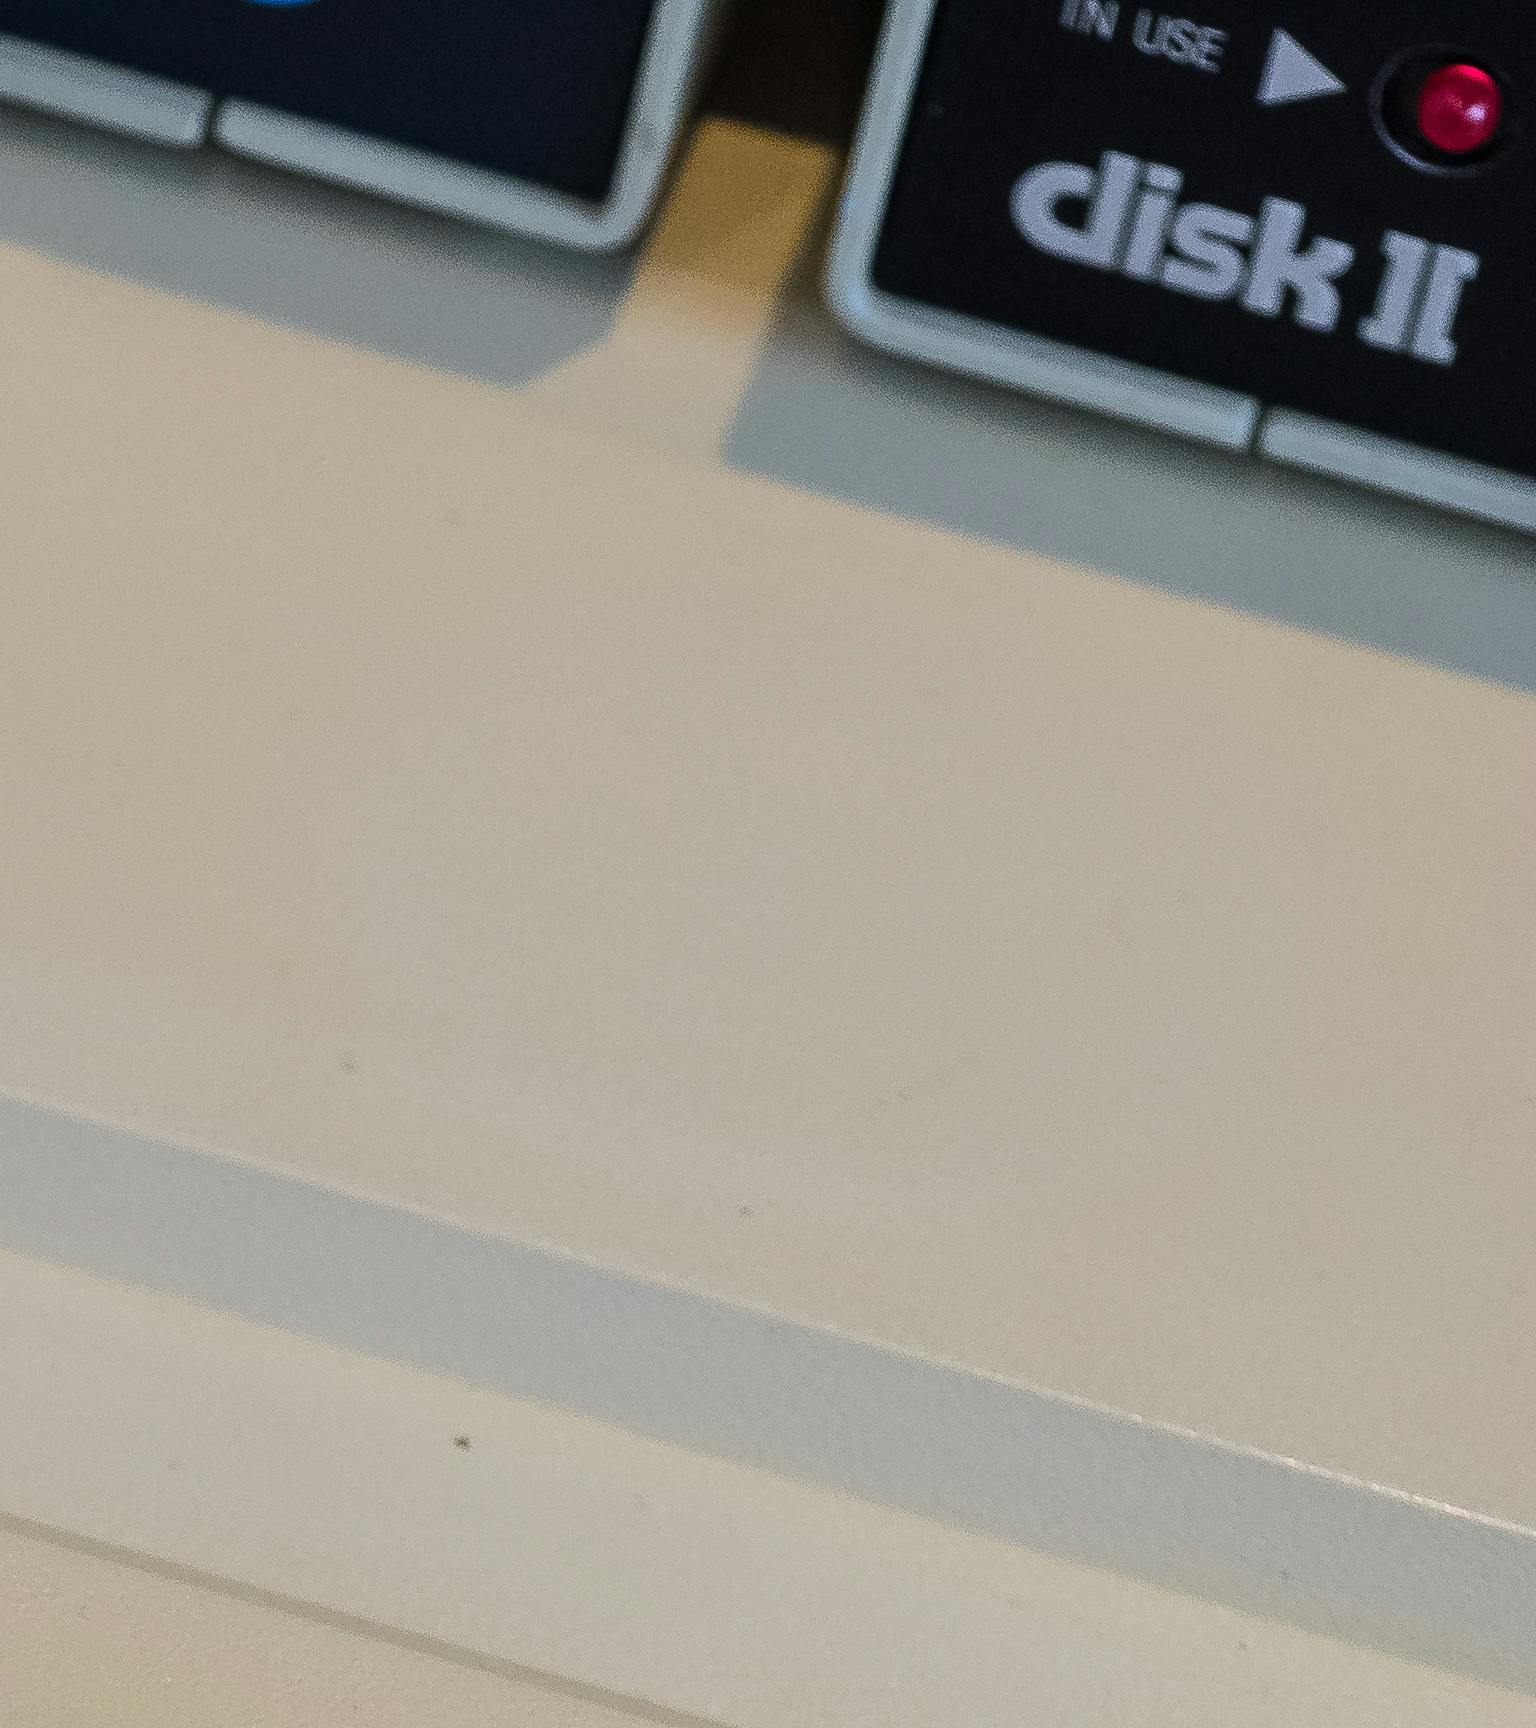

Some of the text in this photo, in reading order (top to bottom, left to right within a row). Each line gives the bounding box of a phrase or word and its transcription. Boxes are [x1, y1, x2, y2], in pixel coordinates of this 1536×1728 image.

[1059, 0, 1230, 74] IN USE
[1009, 149, 1481, 367] disk II
